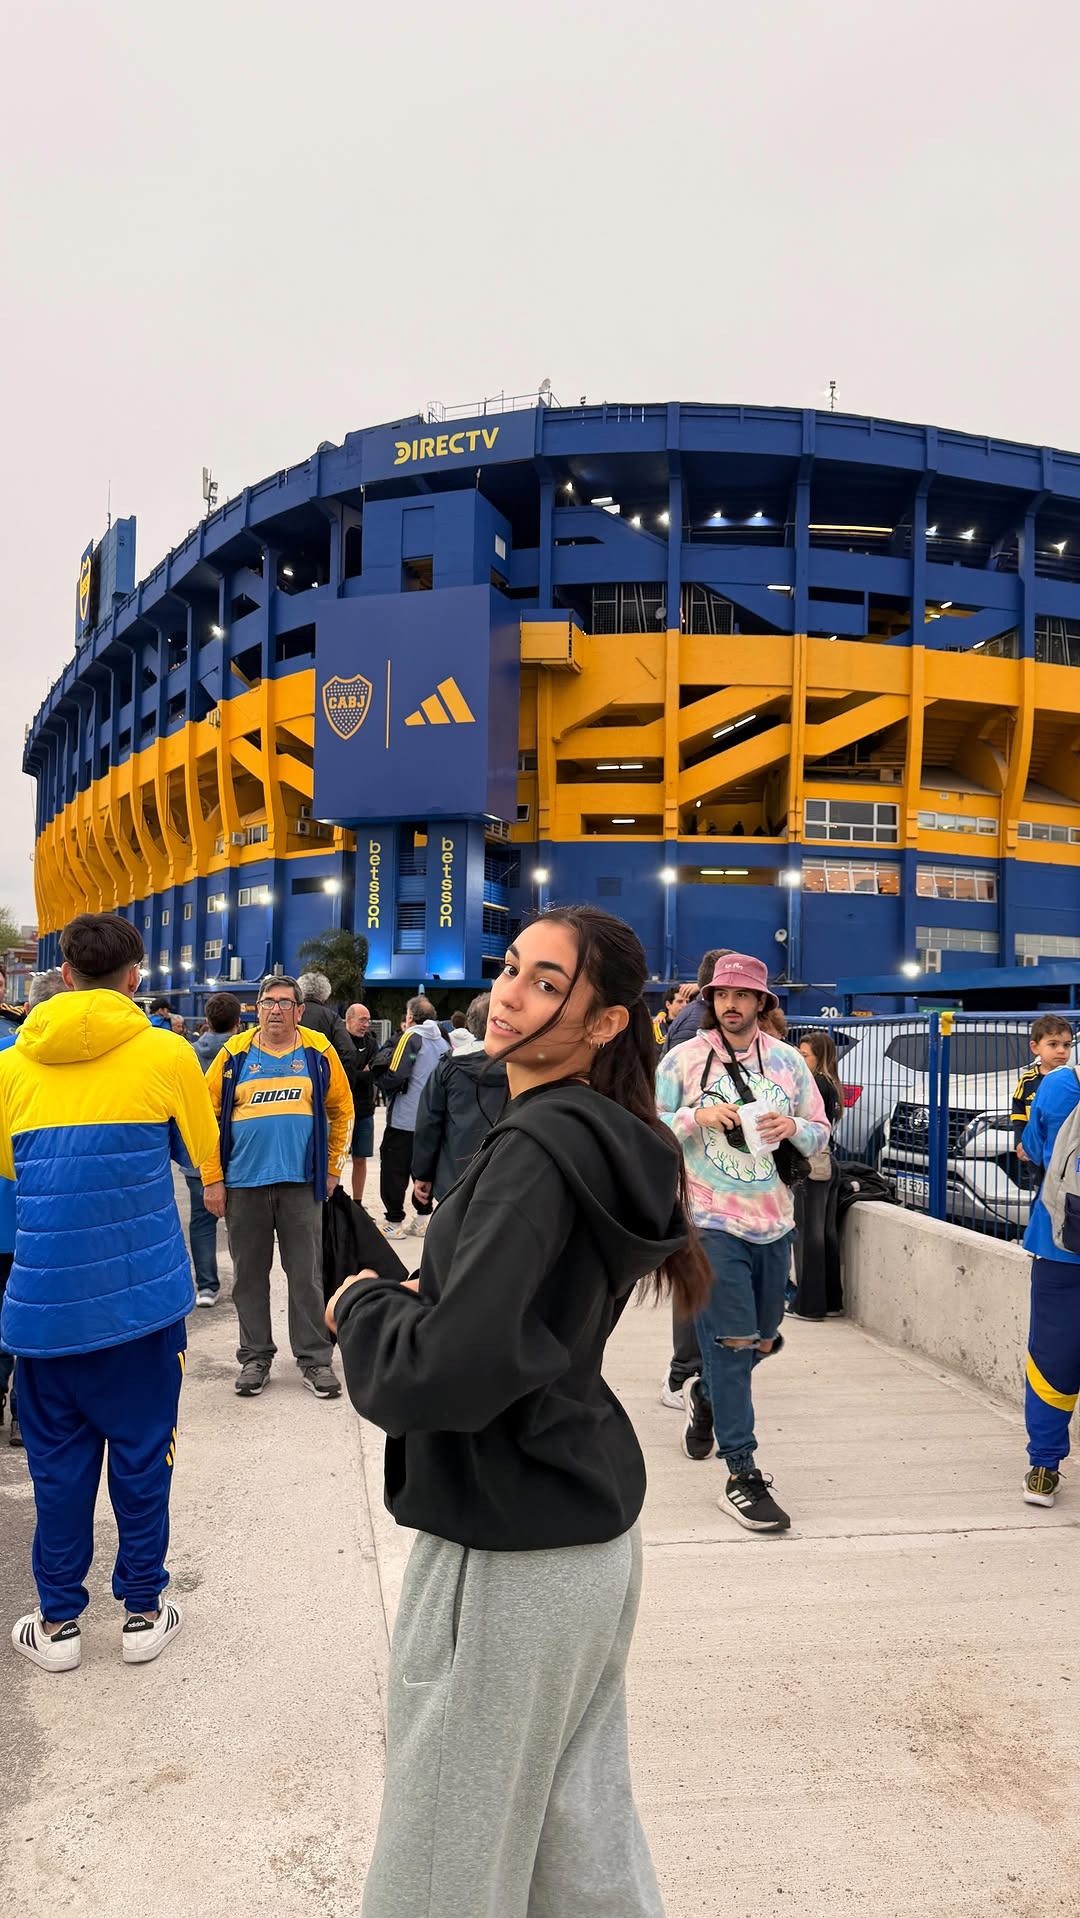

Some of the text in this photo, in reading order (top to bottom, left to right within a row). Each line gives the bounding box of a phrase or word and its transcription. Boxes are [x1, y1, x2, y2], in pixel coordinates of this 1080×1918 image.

[394, 427, 499, 465] DIRECTV
[329, 695, 365, 709] CABJ
[367, 840, 381, 928] betsson
[440, 837, 454, 927] betsson
[821, 1006, 838, 1018] 20
[253, 1089, 301, 1103] FIAT
[61, 1627, 79, 1636] adidas
